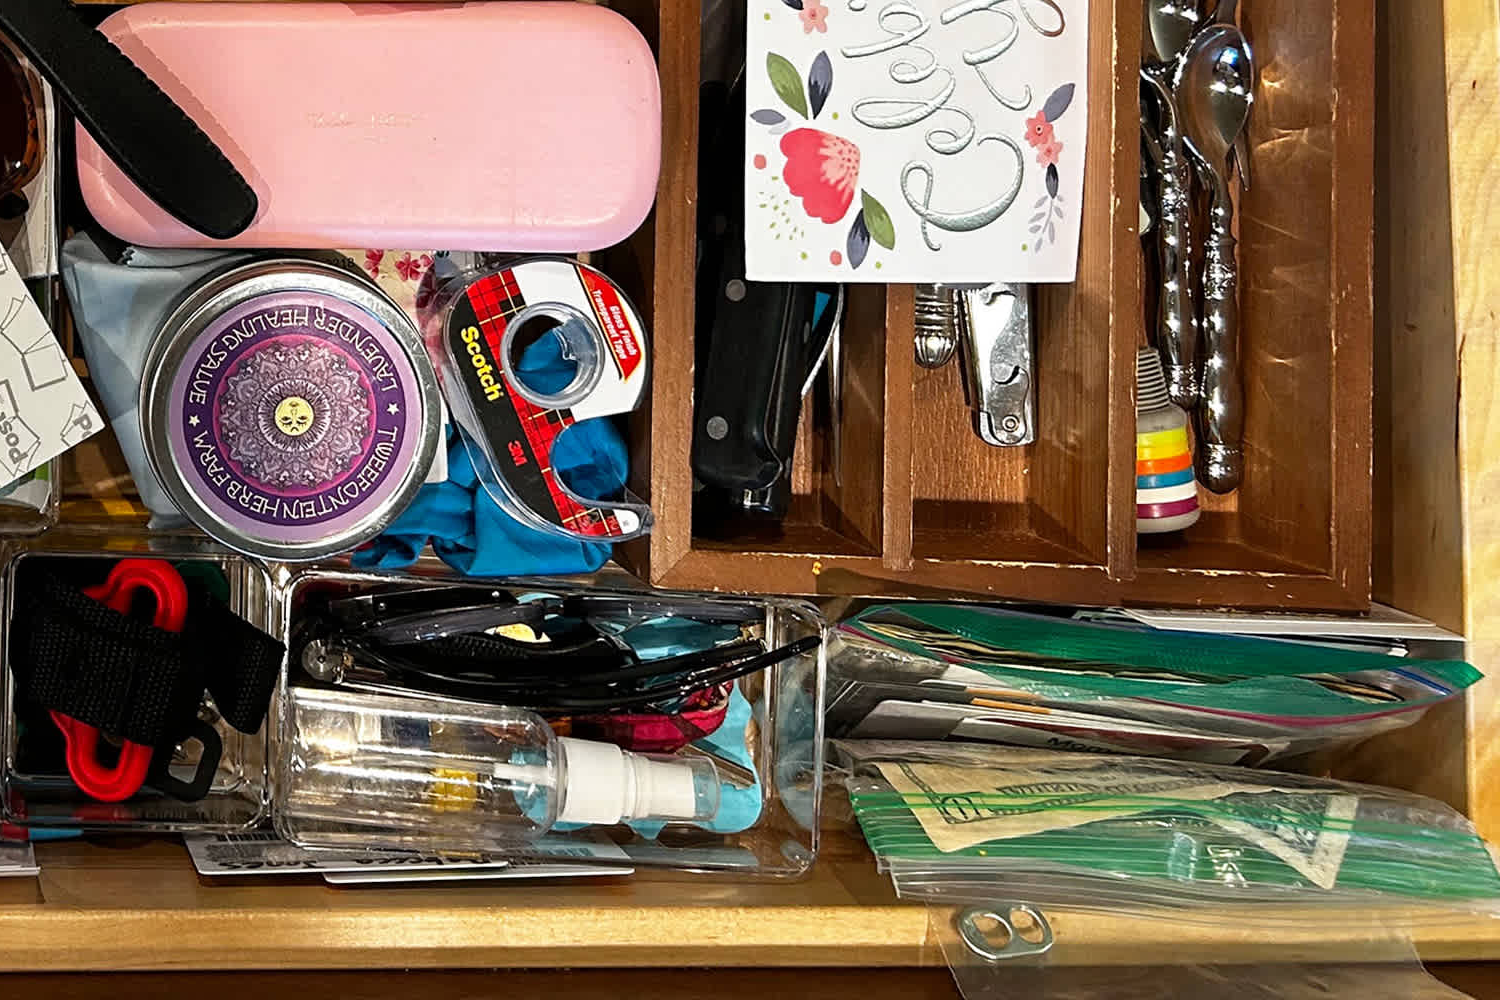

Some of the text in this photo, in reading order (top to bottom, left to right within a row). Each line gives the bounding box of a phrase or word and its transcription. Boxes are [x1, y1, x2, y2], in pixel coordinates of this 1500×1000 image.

[222, 307, 309, 350] HEALING
[593, 289, 628, 360] Transparent Tape
[460, 326, 504, 402] Scotch
[193, 431, 224, 487] FARM
[507, 440, 528, 467] 3M
[227, 481, 278, 518] HERB
